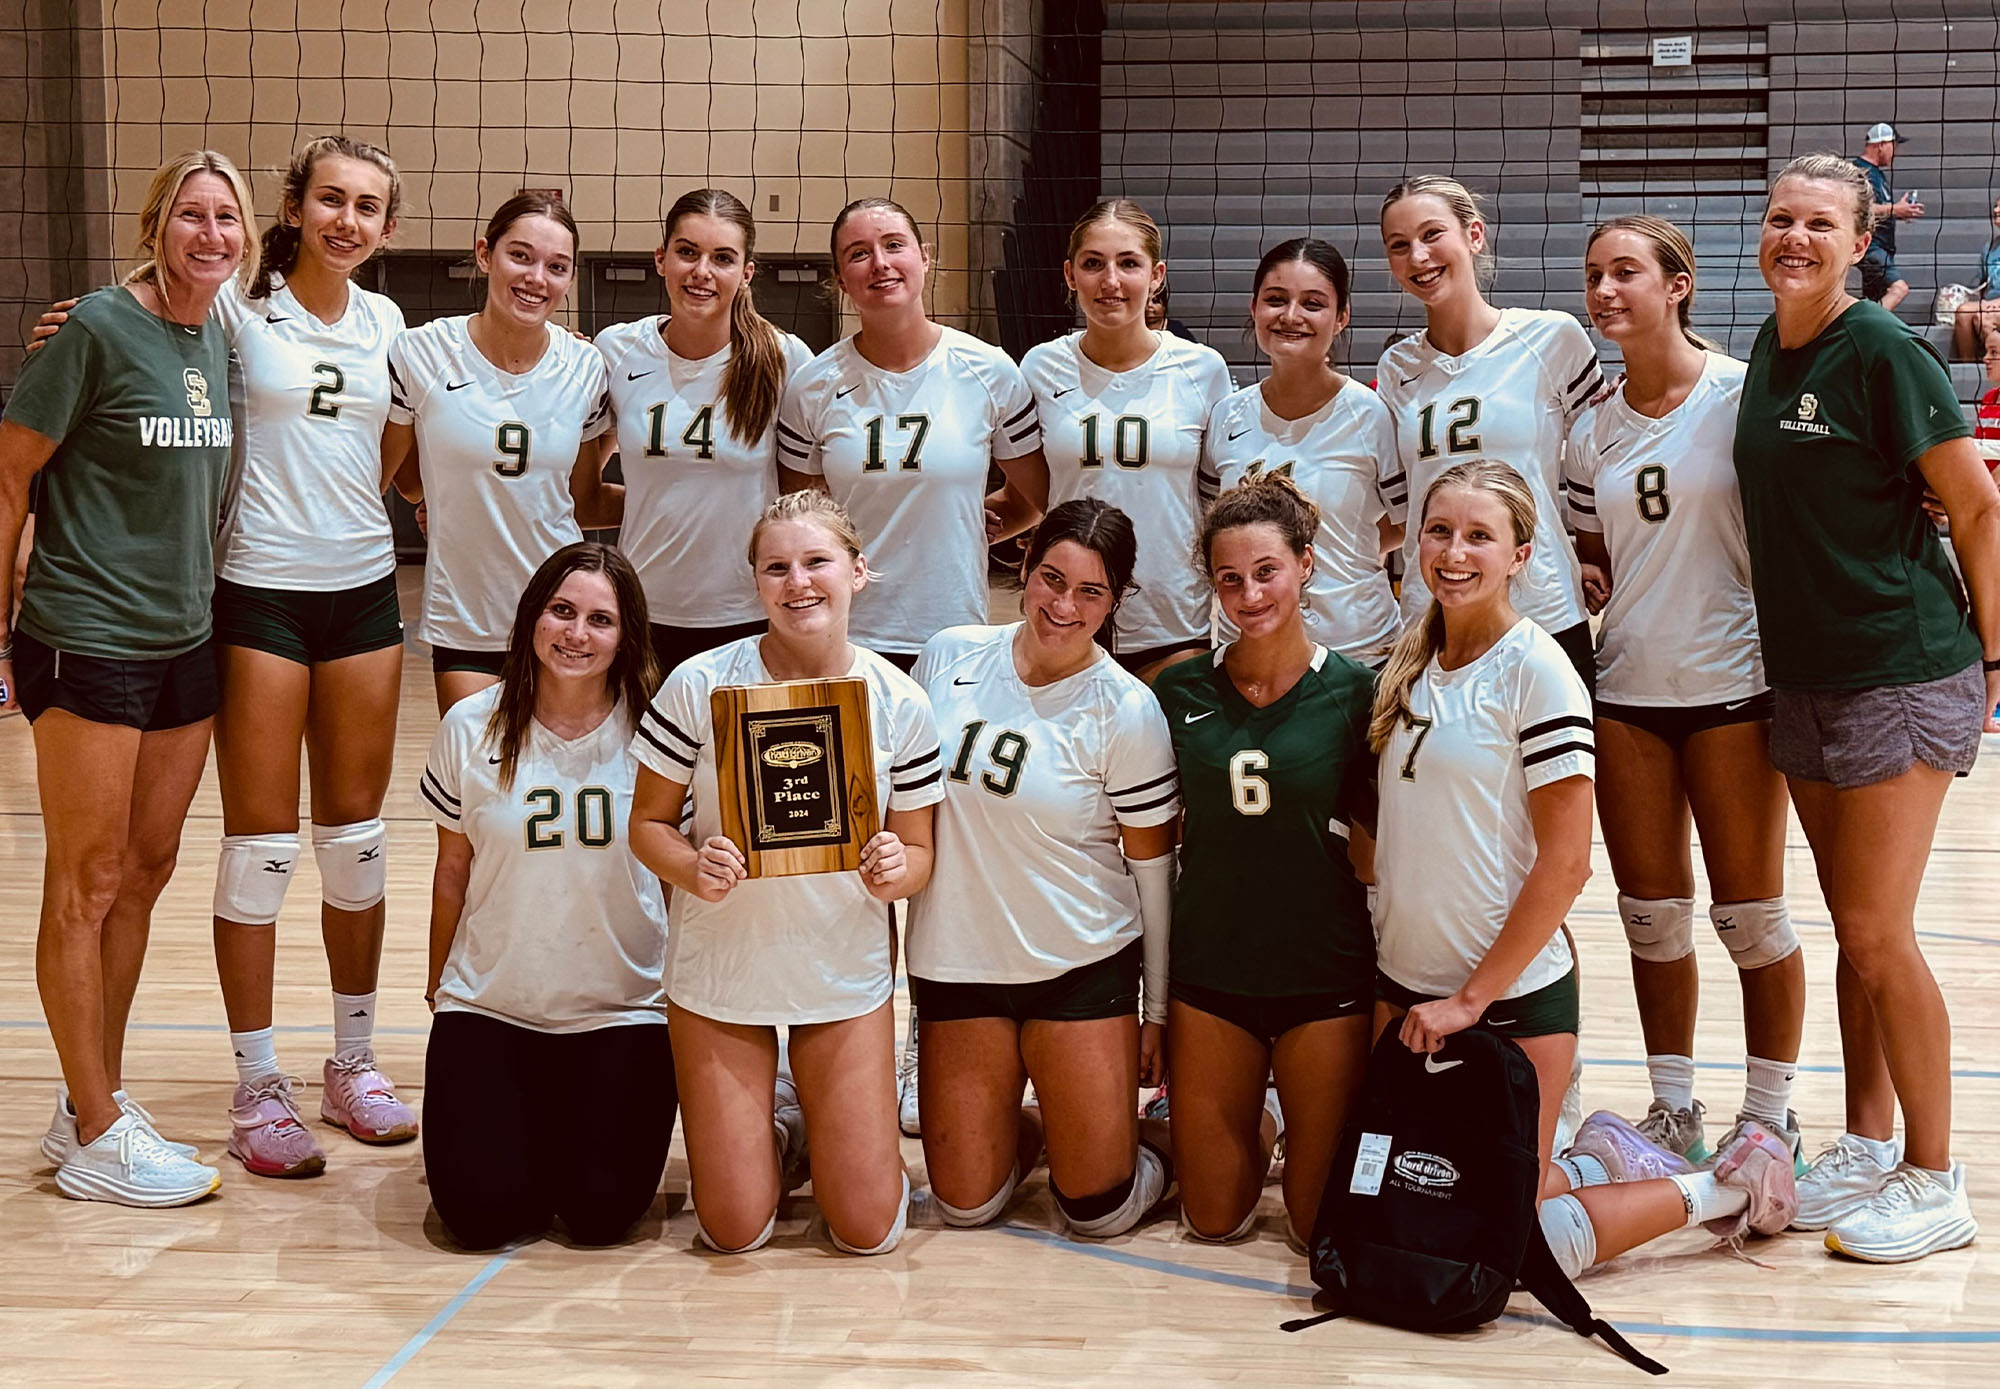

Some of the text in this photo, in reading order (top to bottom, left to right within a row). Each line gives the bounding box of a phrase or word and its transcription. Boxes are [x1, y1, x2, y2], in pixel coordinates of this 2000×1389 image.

[306, 361, 346, 421] 2
[492, 420, 531, 480] 9
[643, 402, 715, 461] 14
[863, 413, 931, 473] 17
[1079, 413, 1150, 471] 10
[1417, 395, 1482, 461] 12
[1780, 420, 1830, 435] VOLLEYBALL
[1634, 462, 1670, 525] 8
[947, 719, 1031, 799] 19
[1400, 714, 1432, 783] 7
[773, 791, 820, 803] Place
[782, 775, 809, 790] 3rd
[1230, 750, 1270, 815] 6
[523, 785, 615, 852] 20
[788, 809, 809, 818] 2024
[1389, 1179, 1401, 1188] ALL
[1404, 1182, 1453, 1200] TOURNAMENT
[1401, 1156, 1424, 1173] hard
[1423, 1163, 1452, 1179] driven
